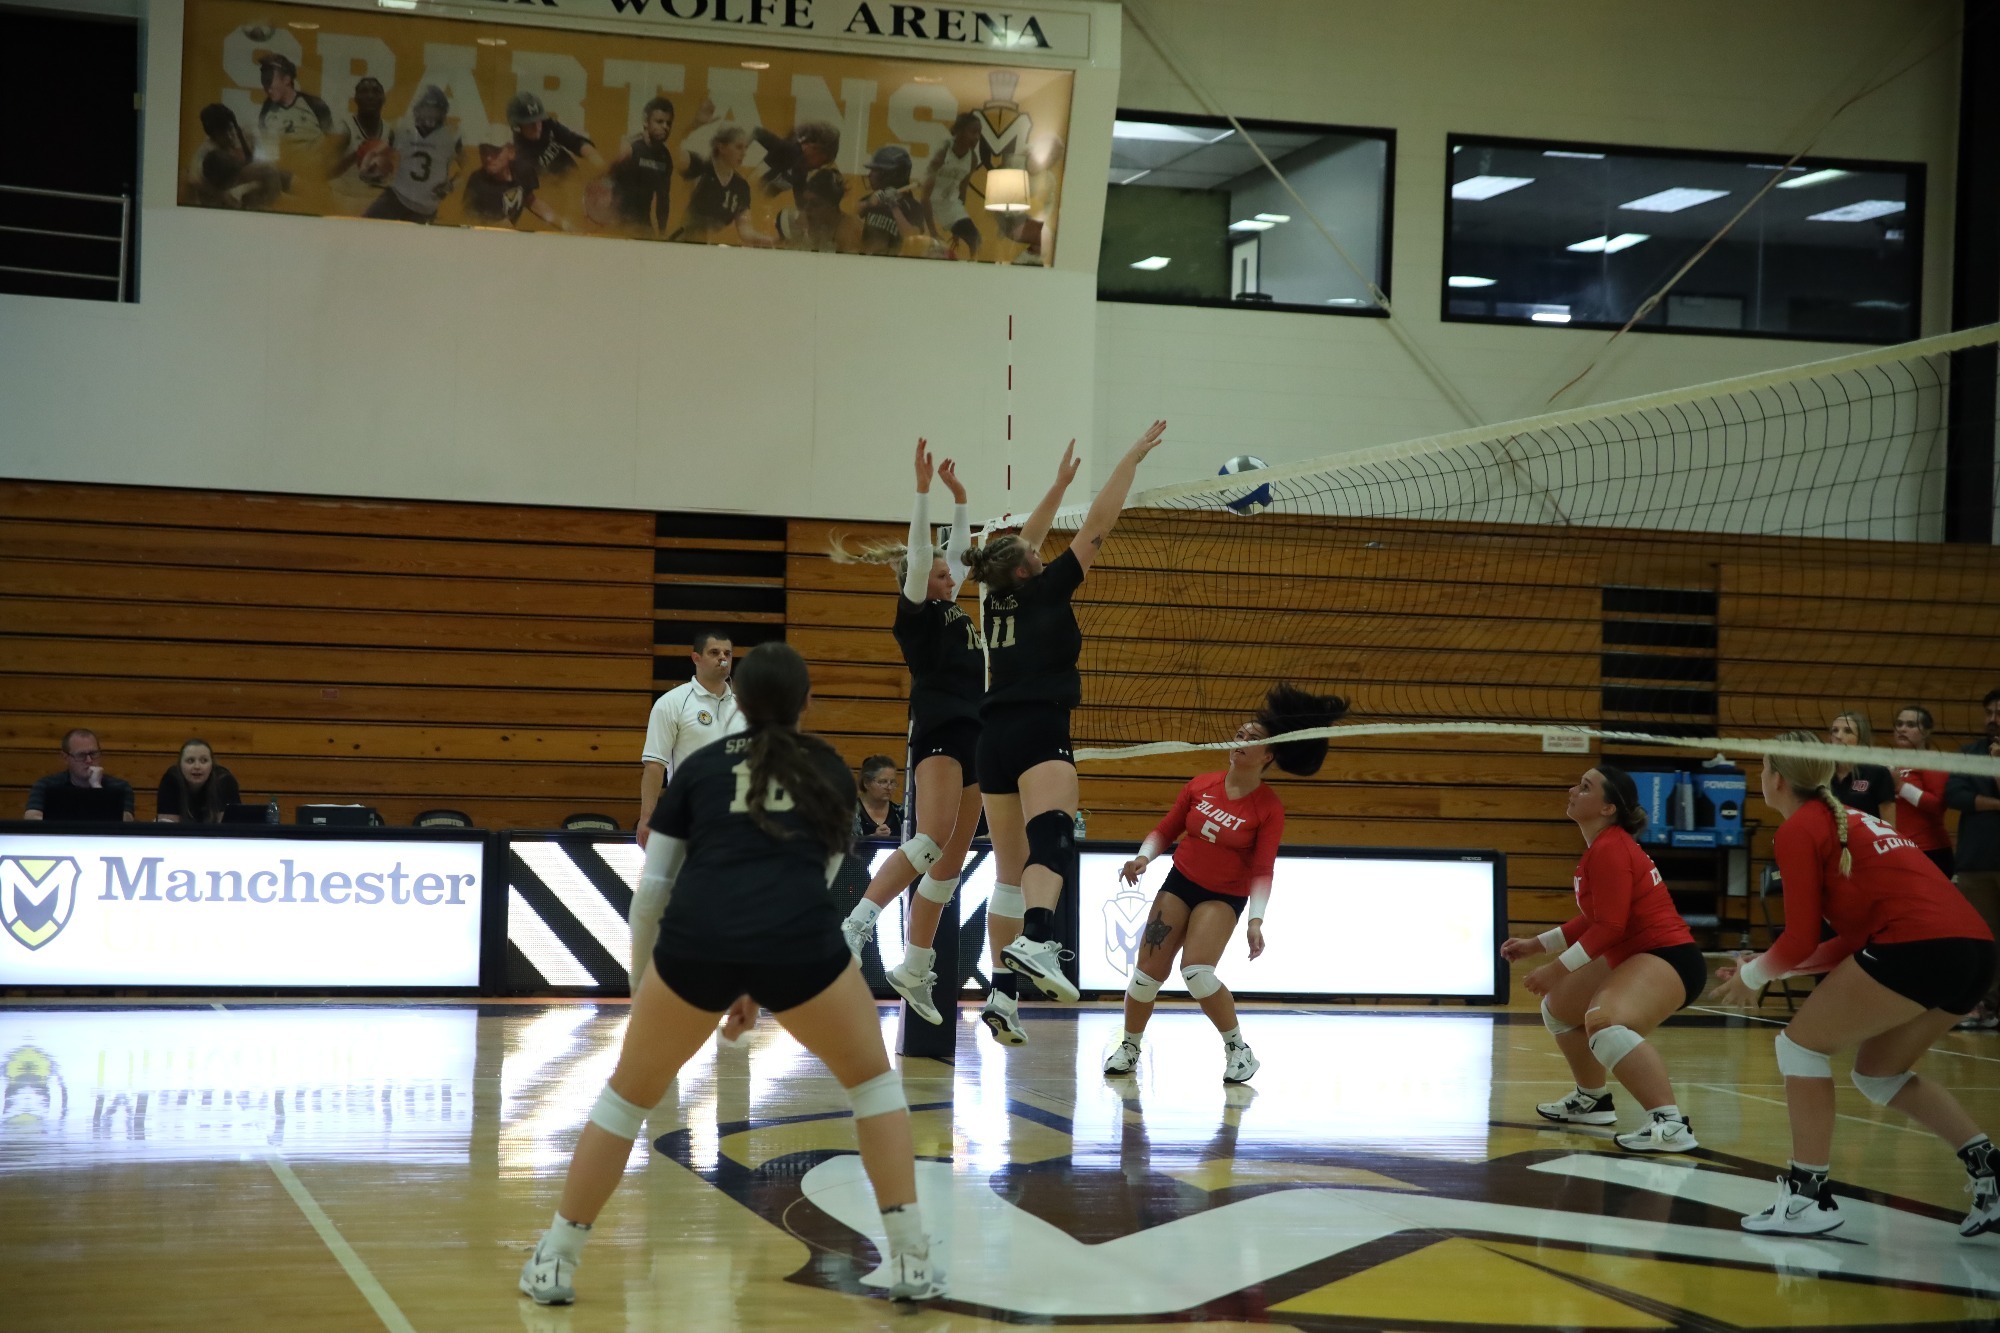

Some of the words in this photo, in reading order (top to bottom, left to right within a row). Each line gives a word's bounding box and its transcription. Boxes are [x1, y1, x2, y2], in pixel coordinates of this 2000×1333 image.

[844, 2, 1052, 48] ARENA
[221, 24, 959, 181] SPARTANS
[410, 151, 432, 182] 3
[990, 616, 1016, 648] 11
[1195, 800, 1246, 831] OLIVET
[1200, 820, 1221, 844] 5
[98, 857, 476, 905] Manchester
